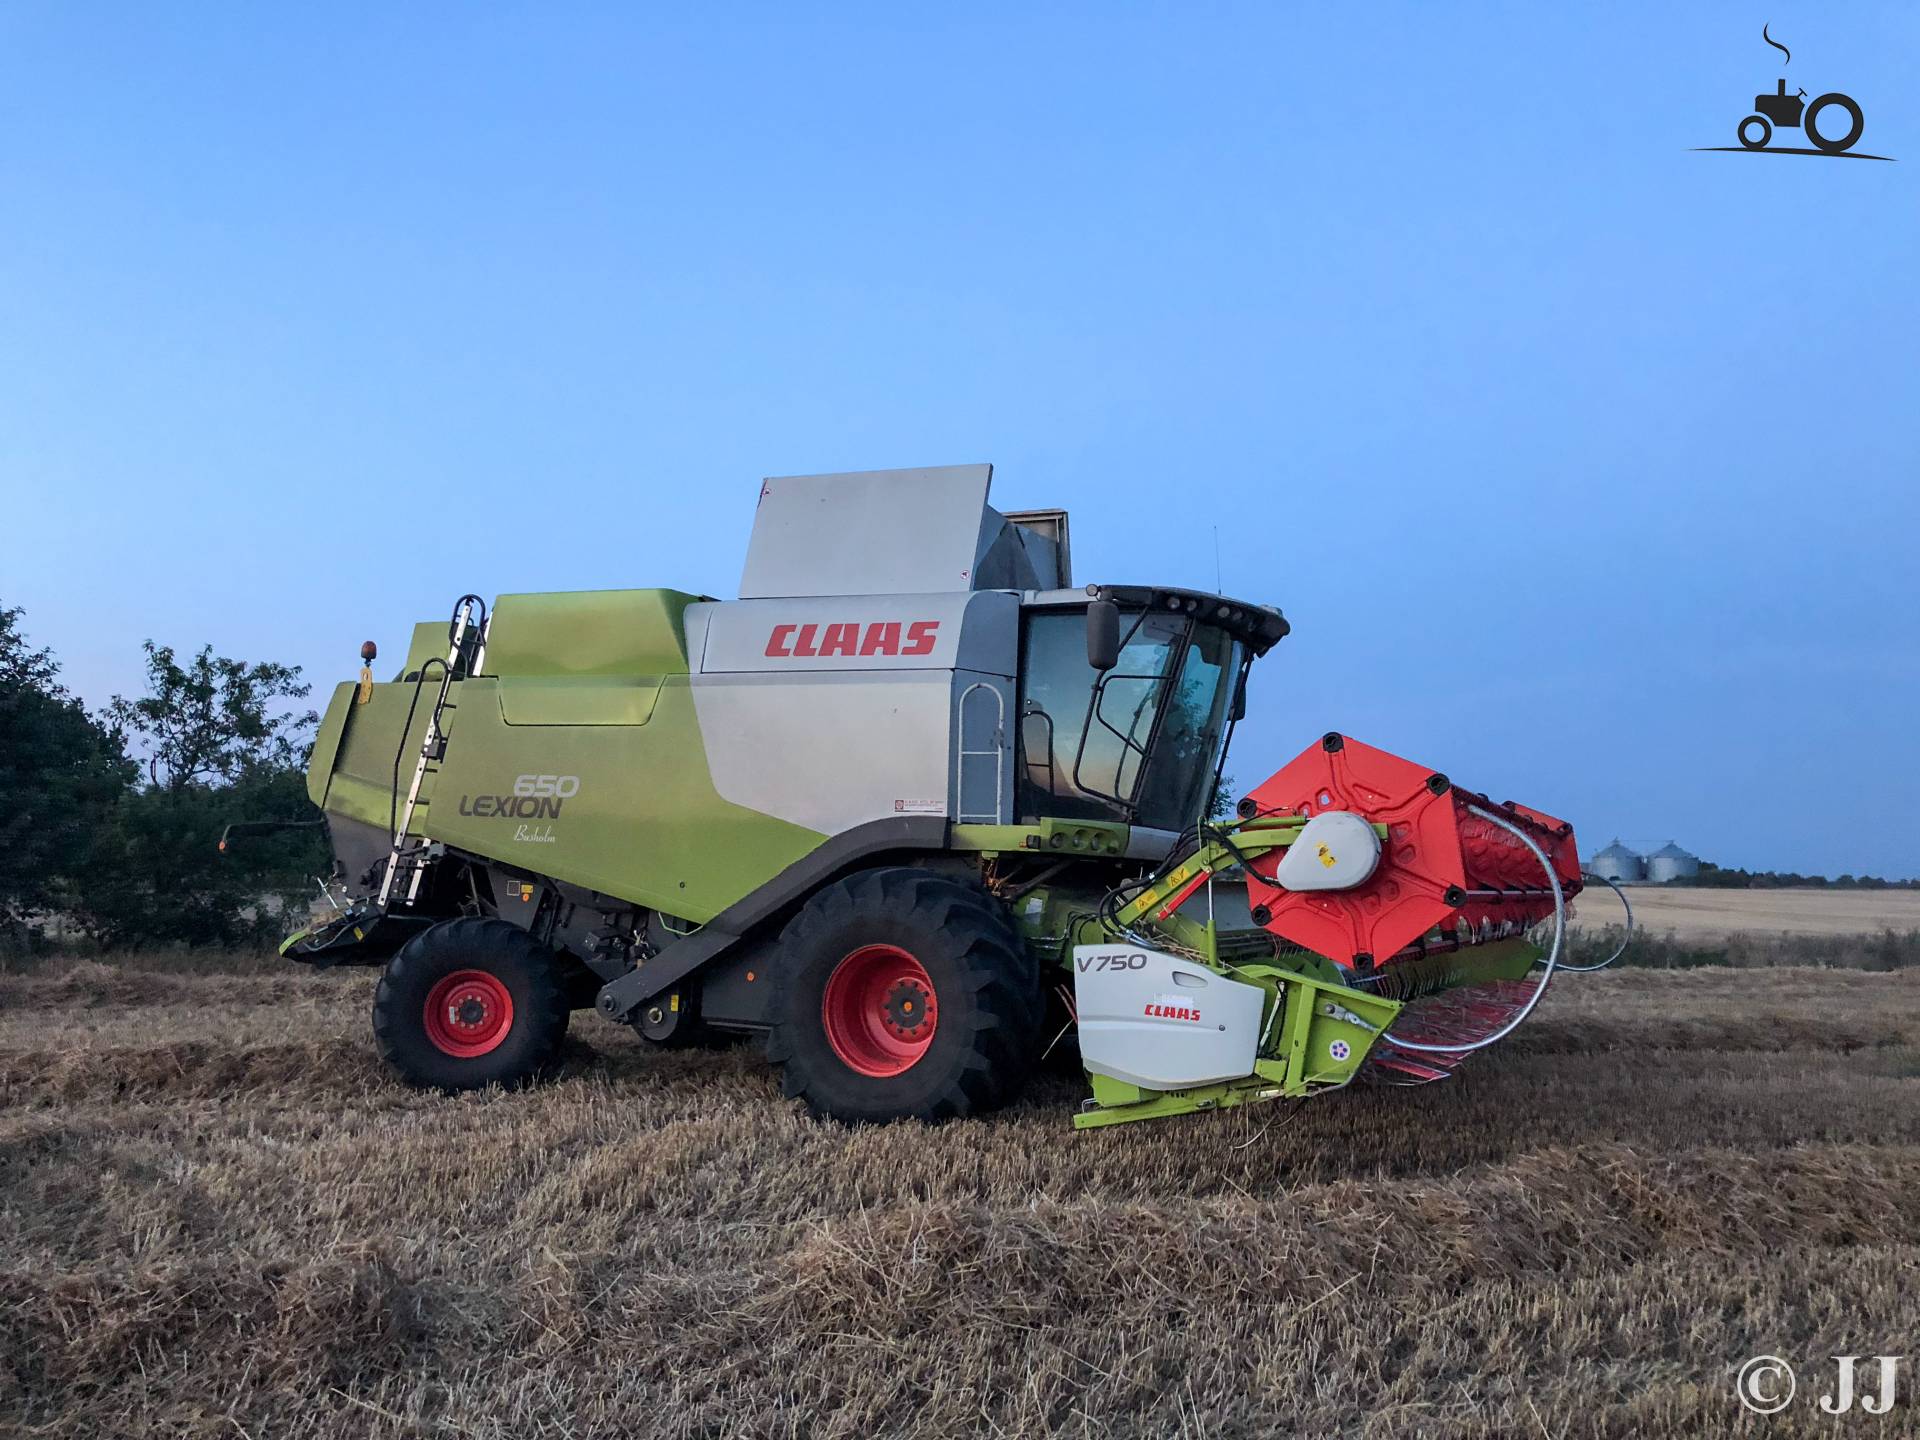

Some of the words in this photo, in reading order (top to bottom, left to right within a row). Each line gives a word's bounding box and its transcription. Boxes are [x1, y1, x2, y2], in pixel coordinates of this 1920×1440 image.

[764, 621, 940, 657] CLAAS
[513, 774, 580, 798] 650
[459, 795, 563, 819] LEXION
[1144, 1004, 1201, 1021] CLAAS
